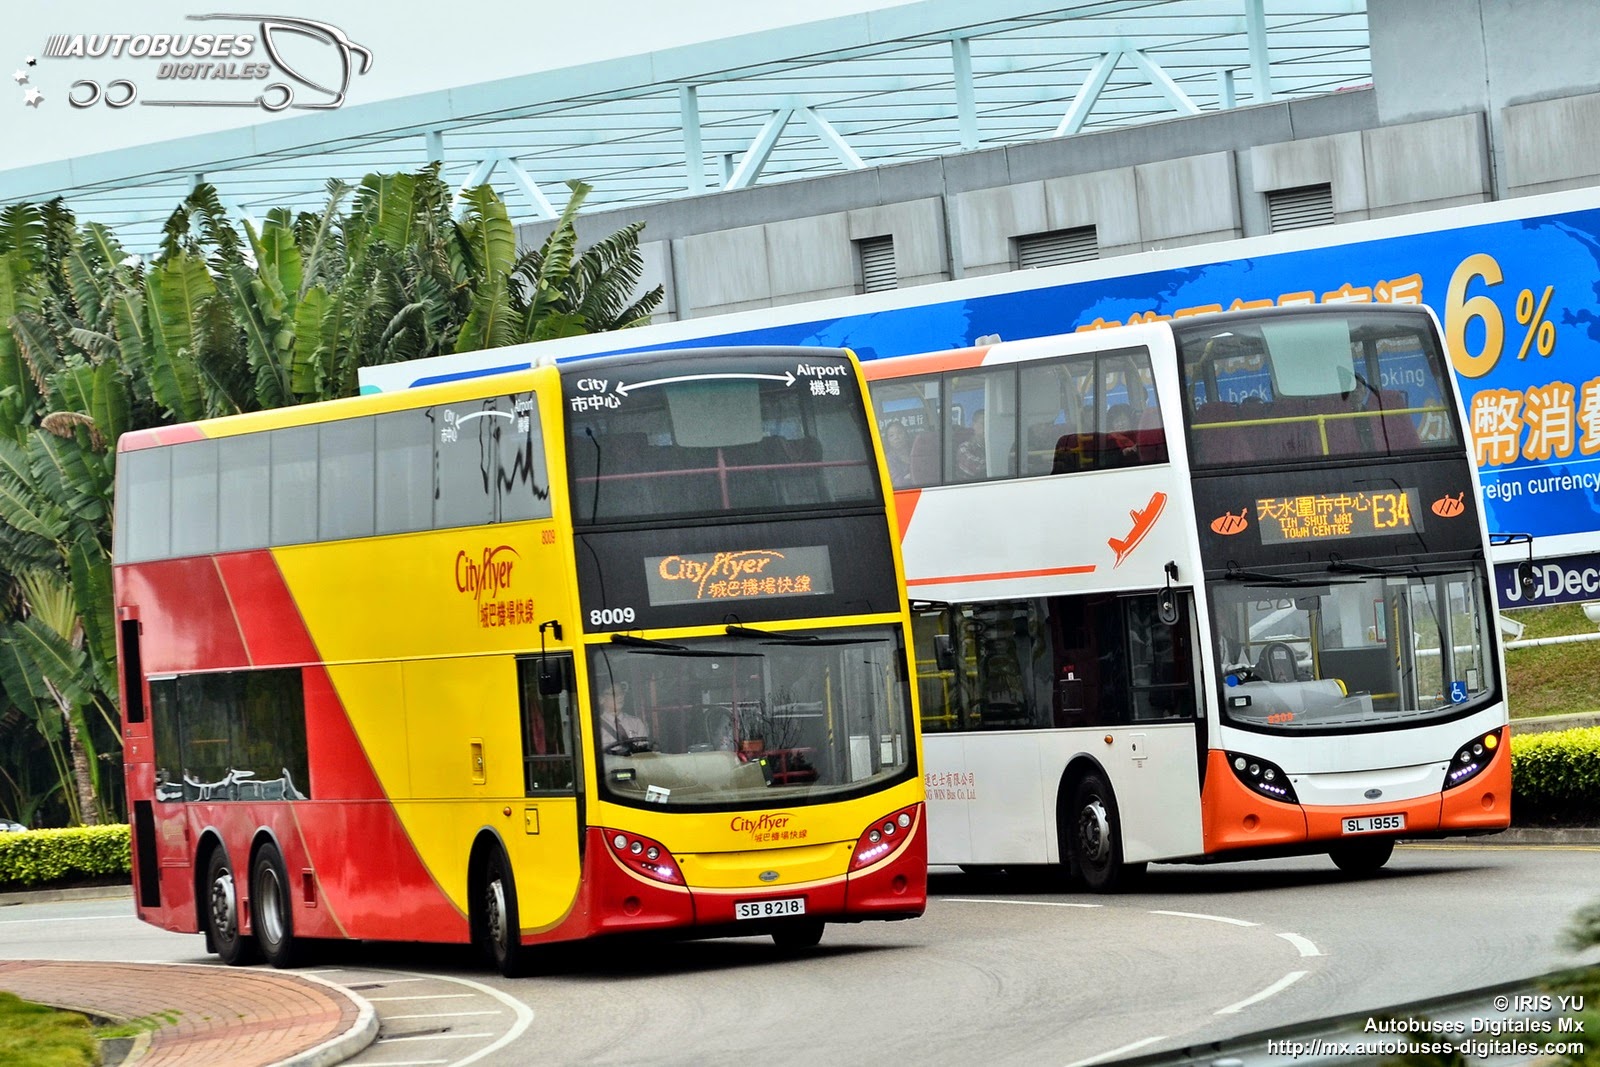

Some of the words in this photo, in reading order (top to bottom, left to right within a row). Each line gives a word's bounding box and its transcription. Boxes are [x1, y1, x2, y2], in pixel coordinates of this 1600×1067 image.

[796, 363, 848, 379] Airport
[576, 378, 609, 394] City
[809, 379, 841, 396] 機場
[570, 393, 622, 413] 市中心
[1482, 479, 1522, 502] reign
[1257, 492, 1372, 521] 天水圍市中心
[1372, 492, 1410, 529] E34
[1278, 516, 1298, 529] TIN
[1304, 513, 1328, 527] SHUI
[1334, 512, 1354, 525] WAI
[1282, 526, 1310, 539] TOWN
[1312, 523, 1352, 537] CENTRE
[708, 574, 812, 599] 城巴機場快線
[589, 606, 636, 626] 8009
[1347, 820, 1365, 832] SL
[1369, 816, 1400, 830] 1955
[741, 904, 760, 917] SB
[764, 900, 800, 915] 8218
